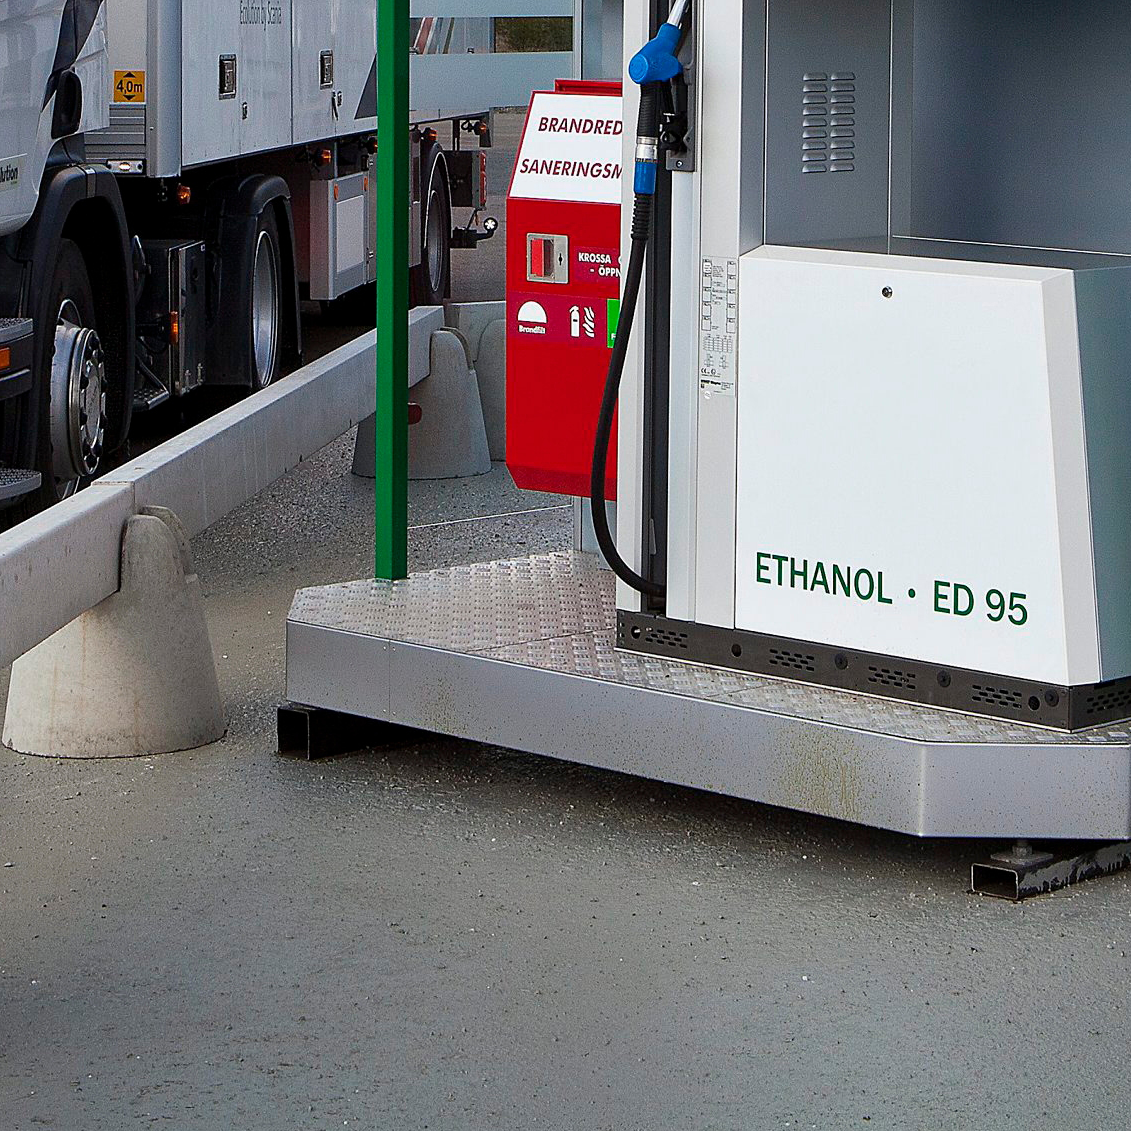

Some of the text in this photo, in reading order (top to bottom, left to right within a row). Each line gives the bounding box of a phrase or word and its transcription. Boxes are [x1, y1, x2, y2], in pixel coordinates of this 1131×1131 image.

[267, 0, 282, 25] Scania
[116, 79, 143, 95] 4,0m
[578, 252, 612, 264] KROSSA
[756, 551, 893, 605] ETHANOL
[934, 580, 974, 617] ED
[985, 588, 1028, 626] 95
